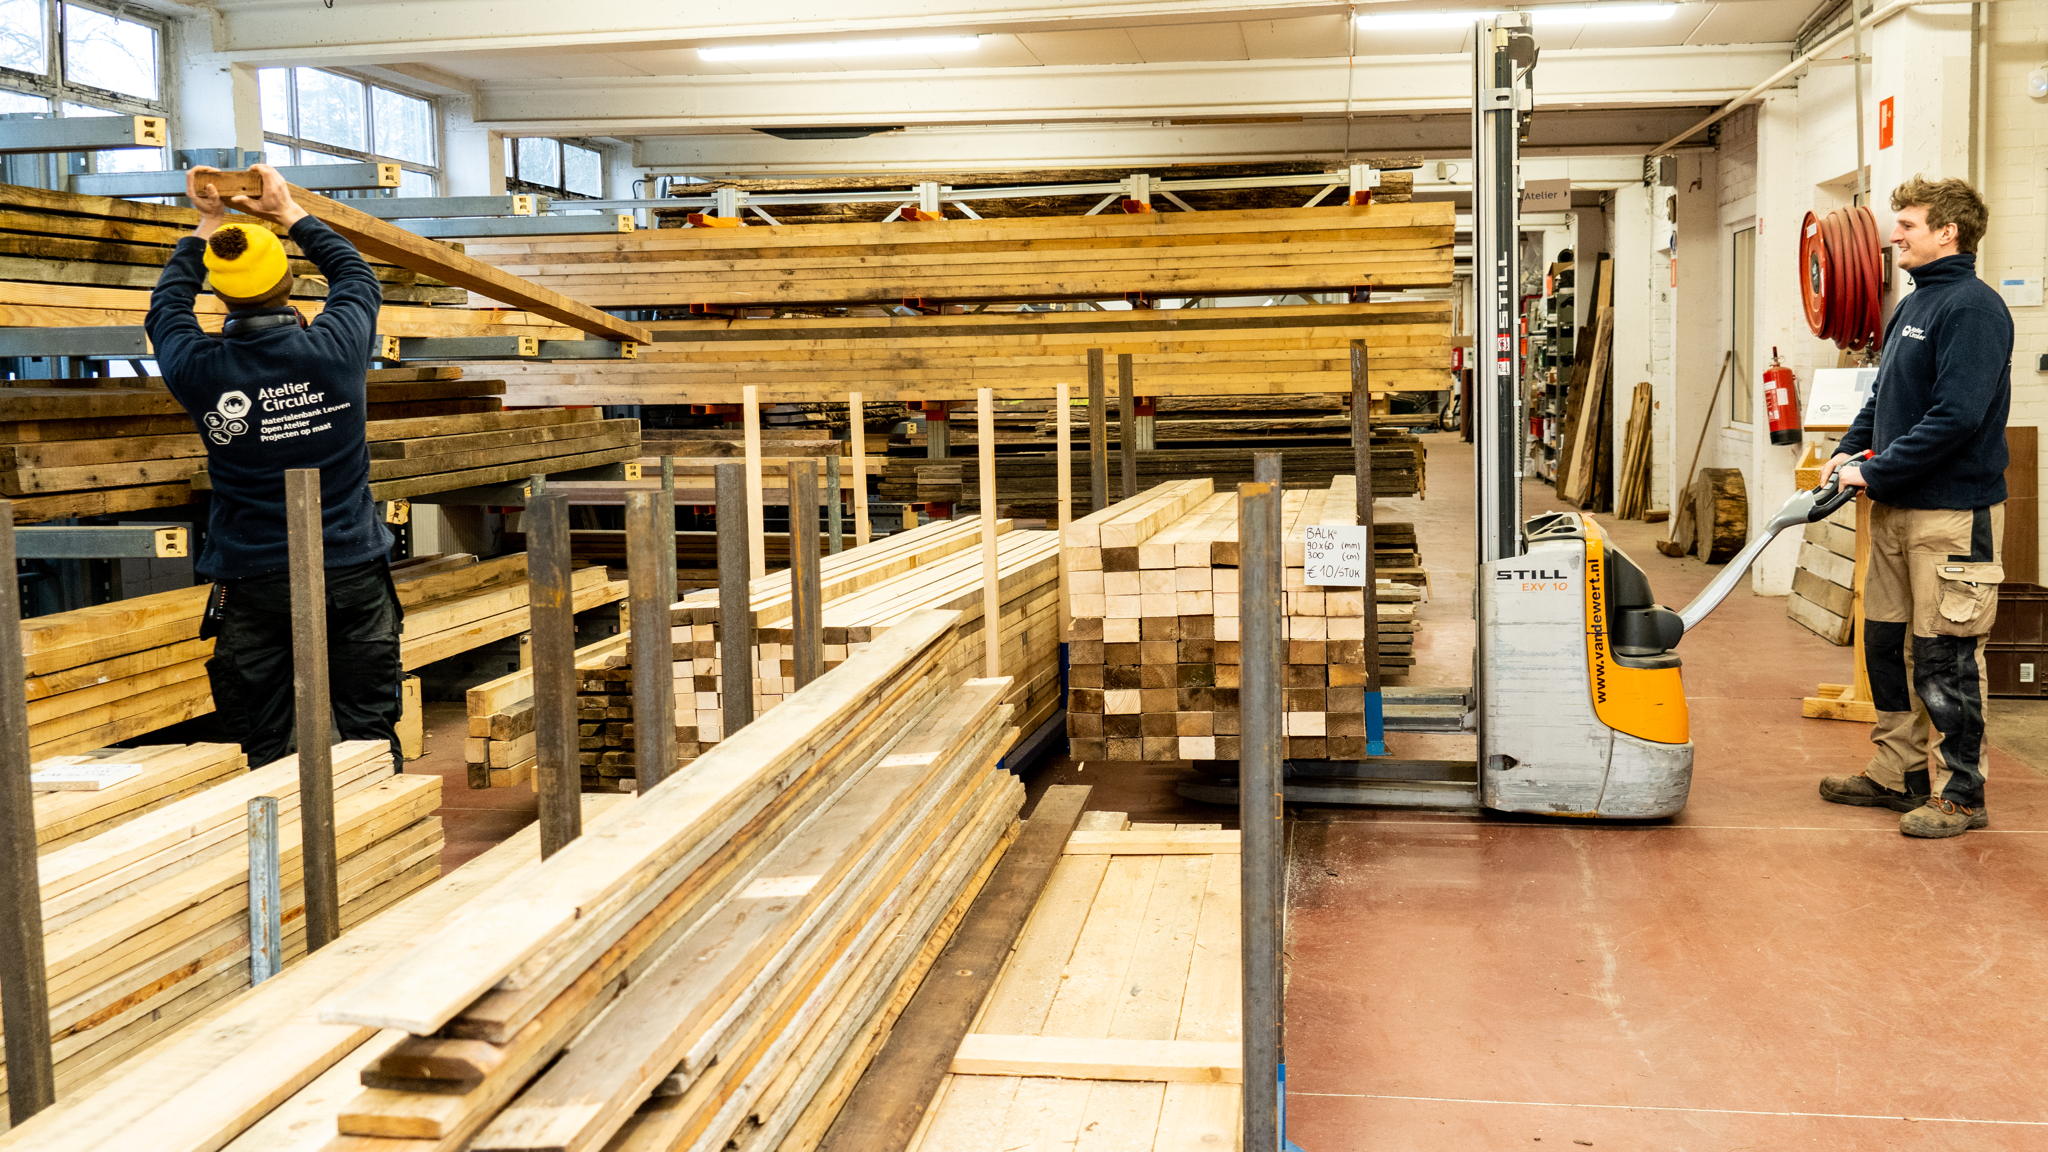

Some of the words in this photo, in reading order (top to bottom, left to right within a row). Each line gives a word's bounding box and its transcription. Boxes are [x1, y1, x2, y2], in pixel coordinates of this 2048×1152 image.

[1525, 191, 1557, 200] Atelier
[1497, 251, 1508, 328] STILL
[258, 382, 310, 400] Atelier
[263, 392, 325, 412] Circuler
[261, 409, 322, 425] Materialenbank
[323, 402, 351, 414] Leuven
[261, 425, 282, 435] Open
[283, 420, 310, 430] Atelier
[261, 431, 299, 442] Projecten
[300, 428, 311, 436] op
[312, 422, 332, 432] maat
[1307, 541, 1334, 551] 90x60
[1341, 542, 1360, 551] (mm)
[1307, 551, 1324, 560] 300
[1342, 551, 1360, 561] (cm)
[1496, 570, 1568, 580] STILL
[1522, 583, 1546, 592] EXV
[1554, 582, 1568, 591] 10
[1588, 559, 1607, 703] www.vandewert.nl
